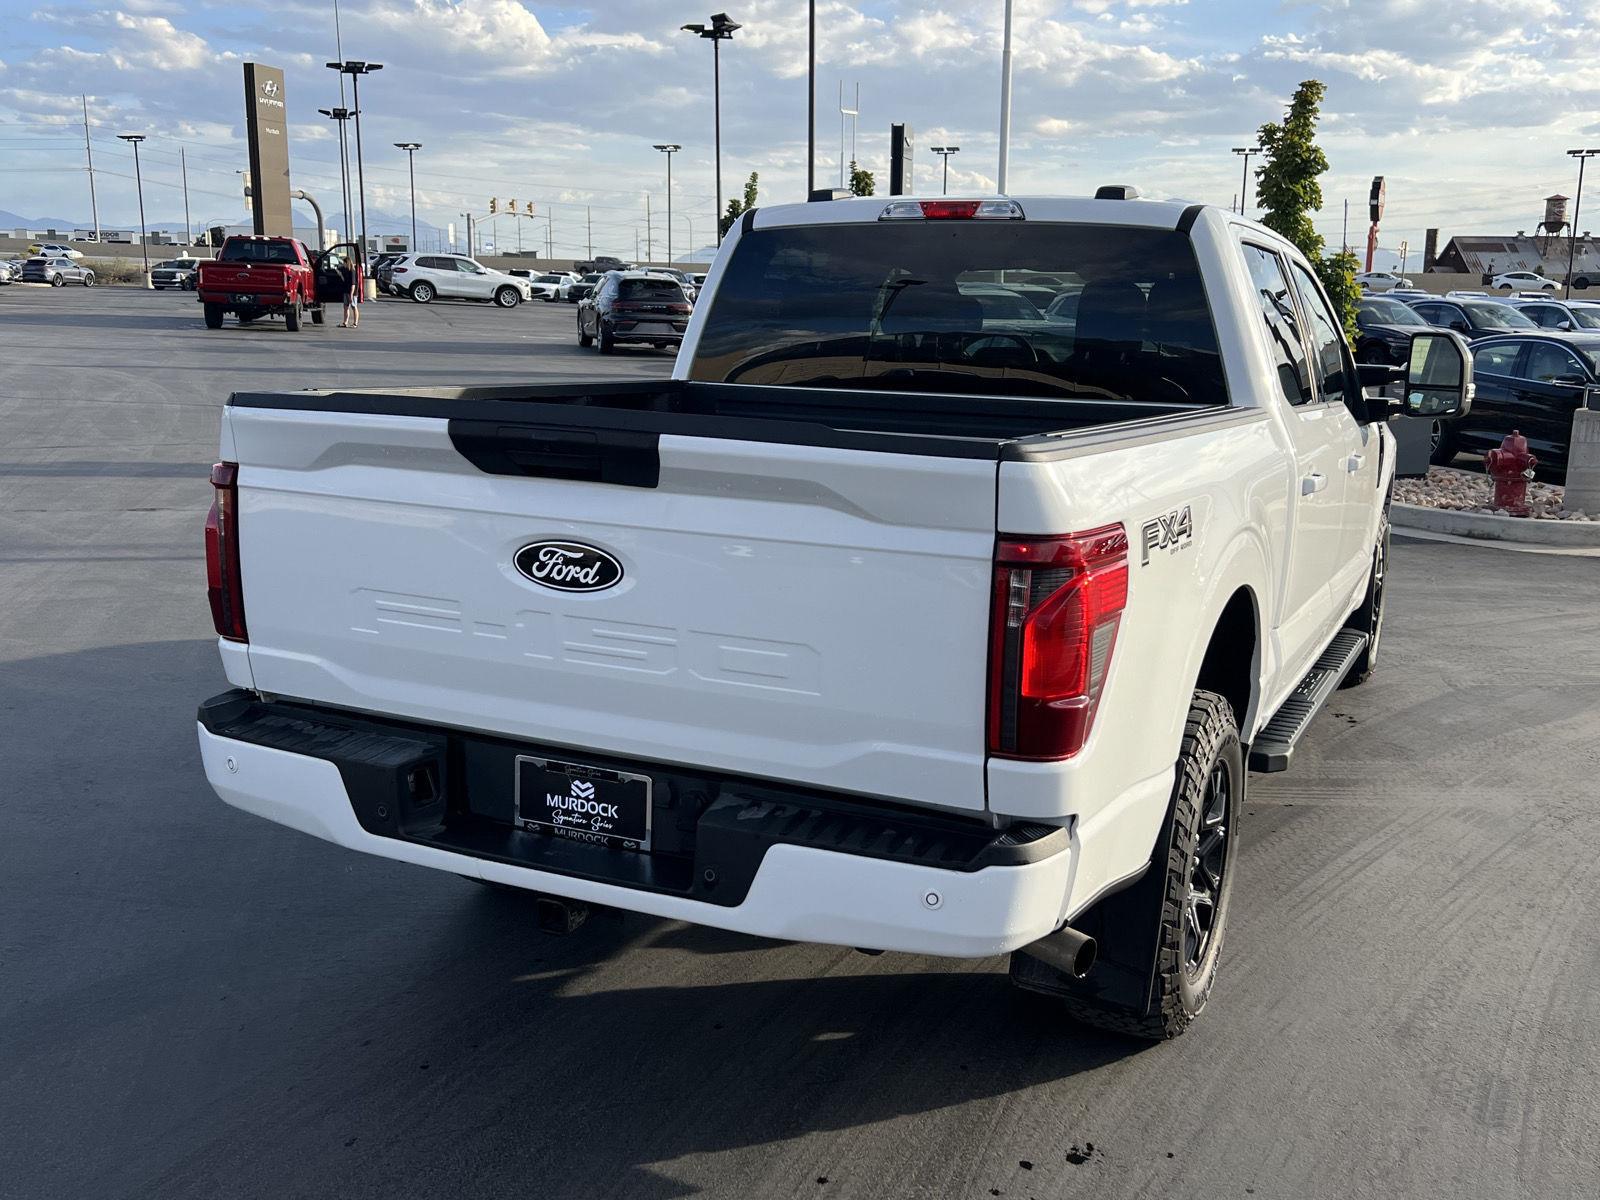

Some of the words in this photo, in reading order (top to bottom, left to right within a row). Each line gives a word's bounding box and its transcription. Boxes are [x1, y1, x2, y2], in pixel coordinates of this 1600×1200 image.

[1141, 504, 1192, 567] FX4
[532, 547, 602, 584] Ford
[350, 587, 822, 696] F-150
[546, 793, 619, 819] MURDOCK
[552, 809, 588, 824] Signature
[590, 816, 613, 831] Series
[554, 827, 609, 846] MURDOCK
